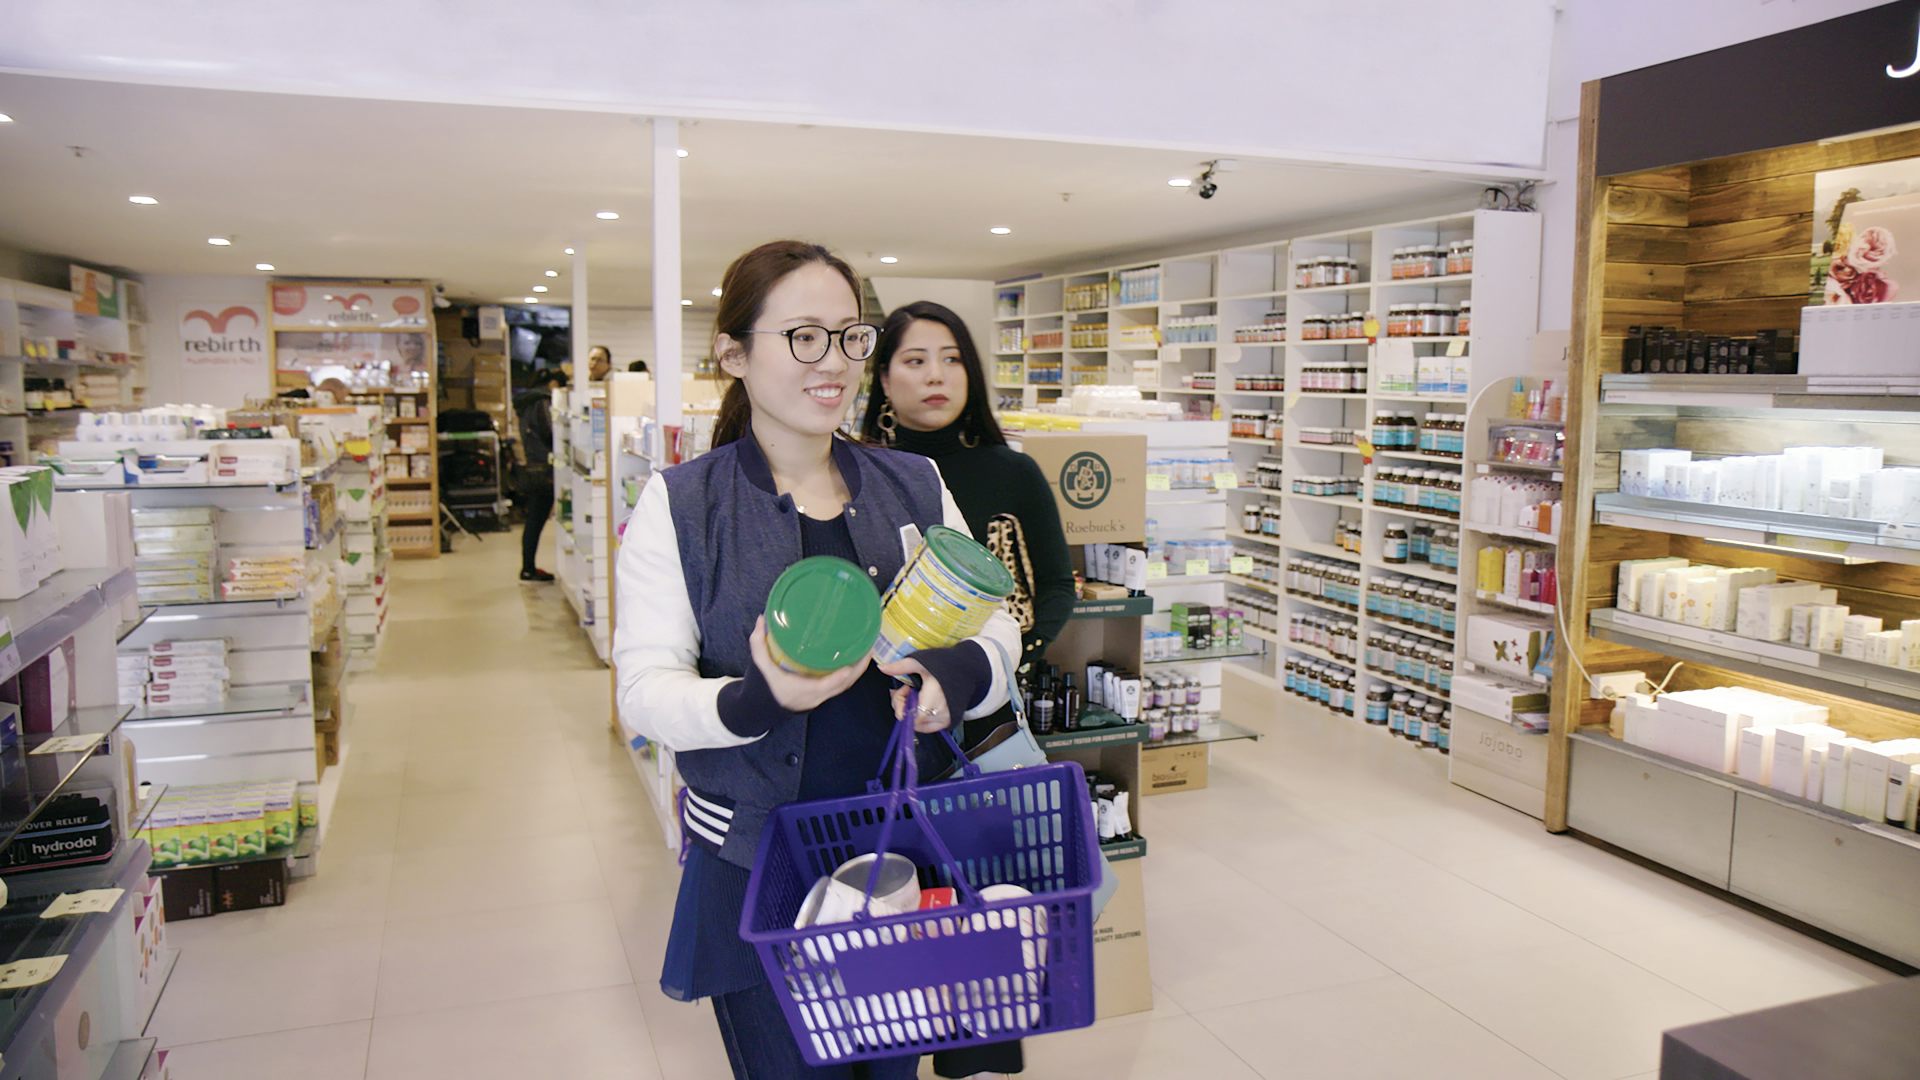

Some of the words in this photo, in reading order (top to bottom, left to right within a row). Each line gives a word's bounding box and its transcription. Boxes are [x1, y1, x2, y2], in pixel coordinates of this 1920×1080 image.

[185, 336, 261, 353] rebirth
[1066, 520, 1126, 534] Roebuck's
[56, 816, 88, 827] RELIEF
[32, 836, 96, 855] hydrodol
